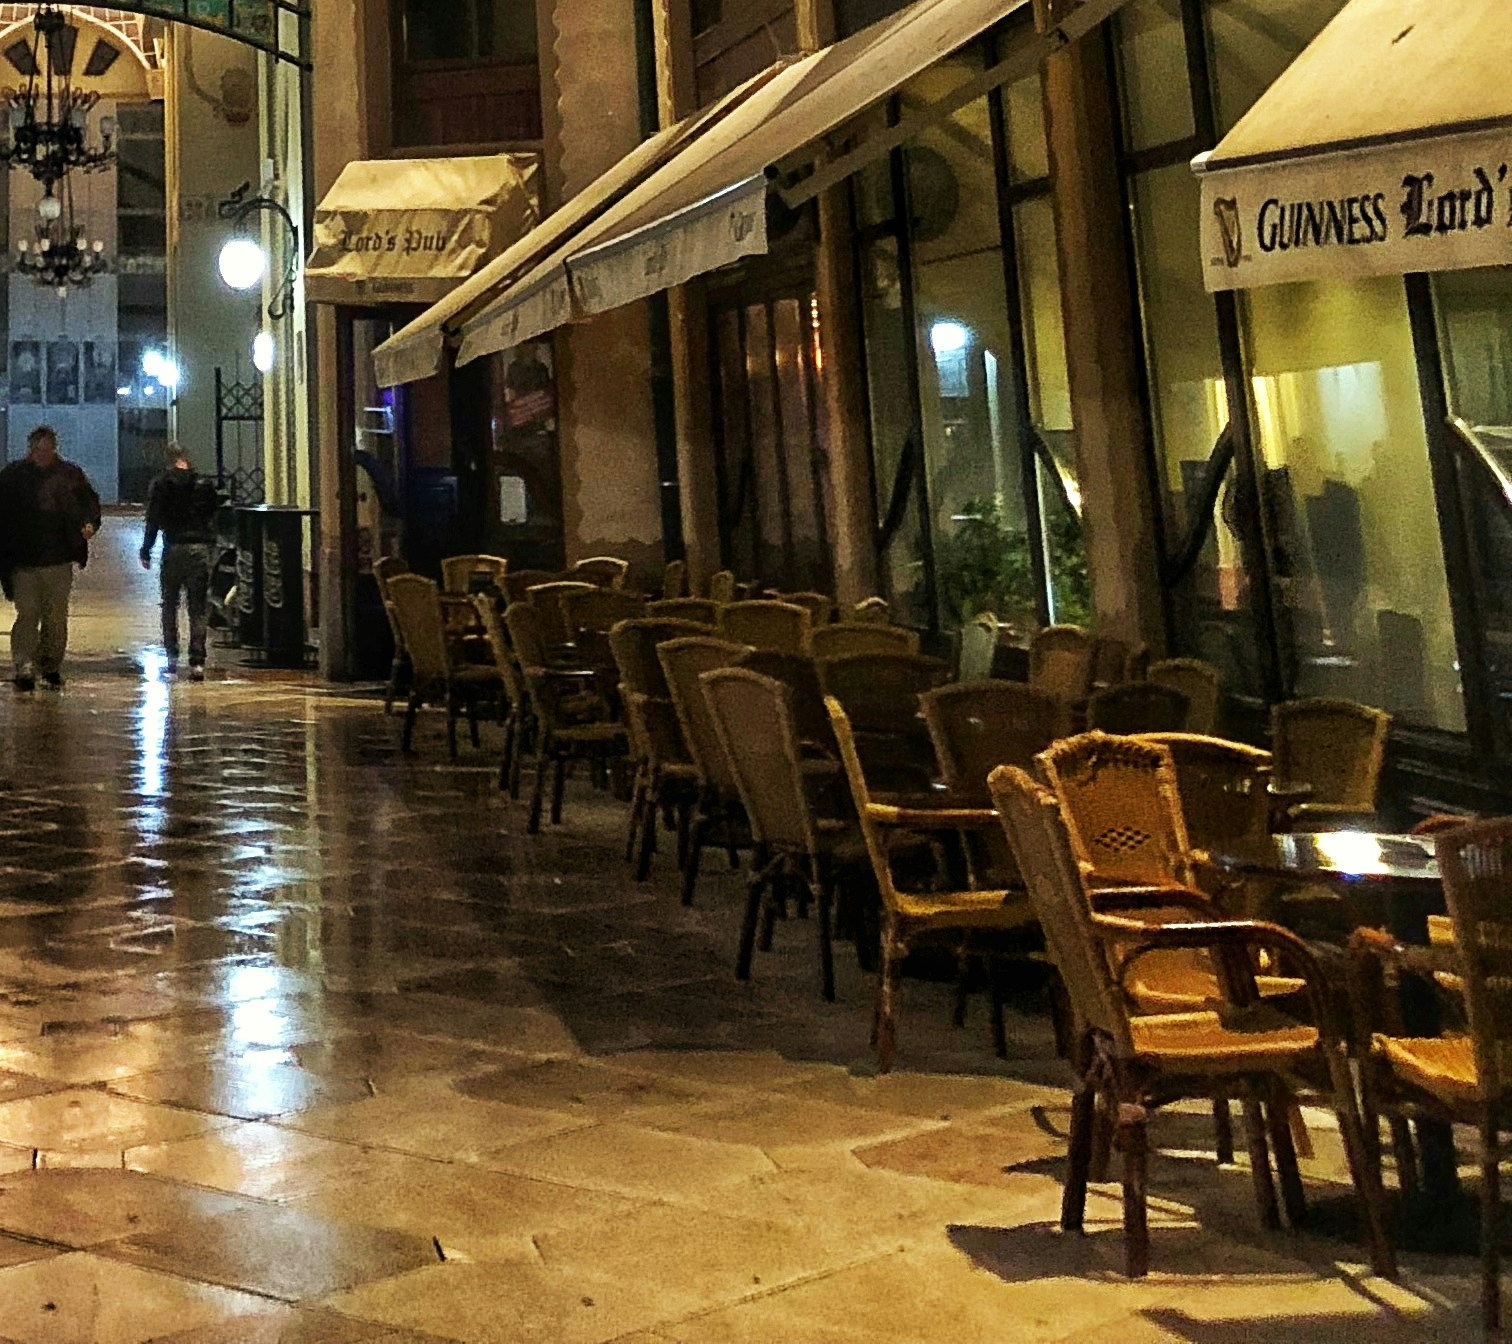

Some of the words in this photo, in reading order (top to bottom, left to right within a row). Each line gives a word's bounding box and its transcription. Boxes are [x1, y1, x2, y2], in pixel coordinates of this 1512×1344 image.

[1256, 192, 1387, 253] GUINNESS
[1400, 162, 1511, 239] Lord'
[341, 229, 398, 253] Lord's
[402, 226, 447, 256] Pub
